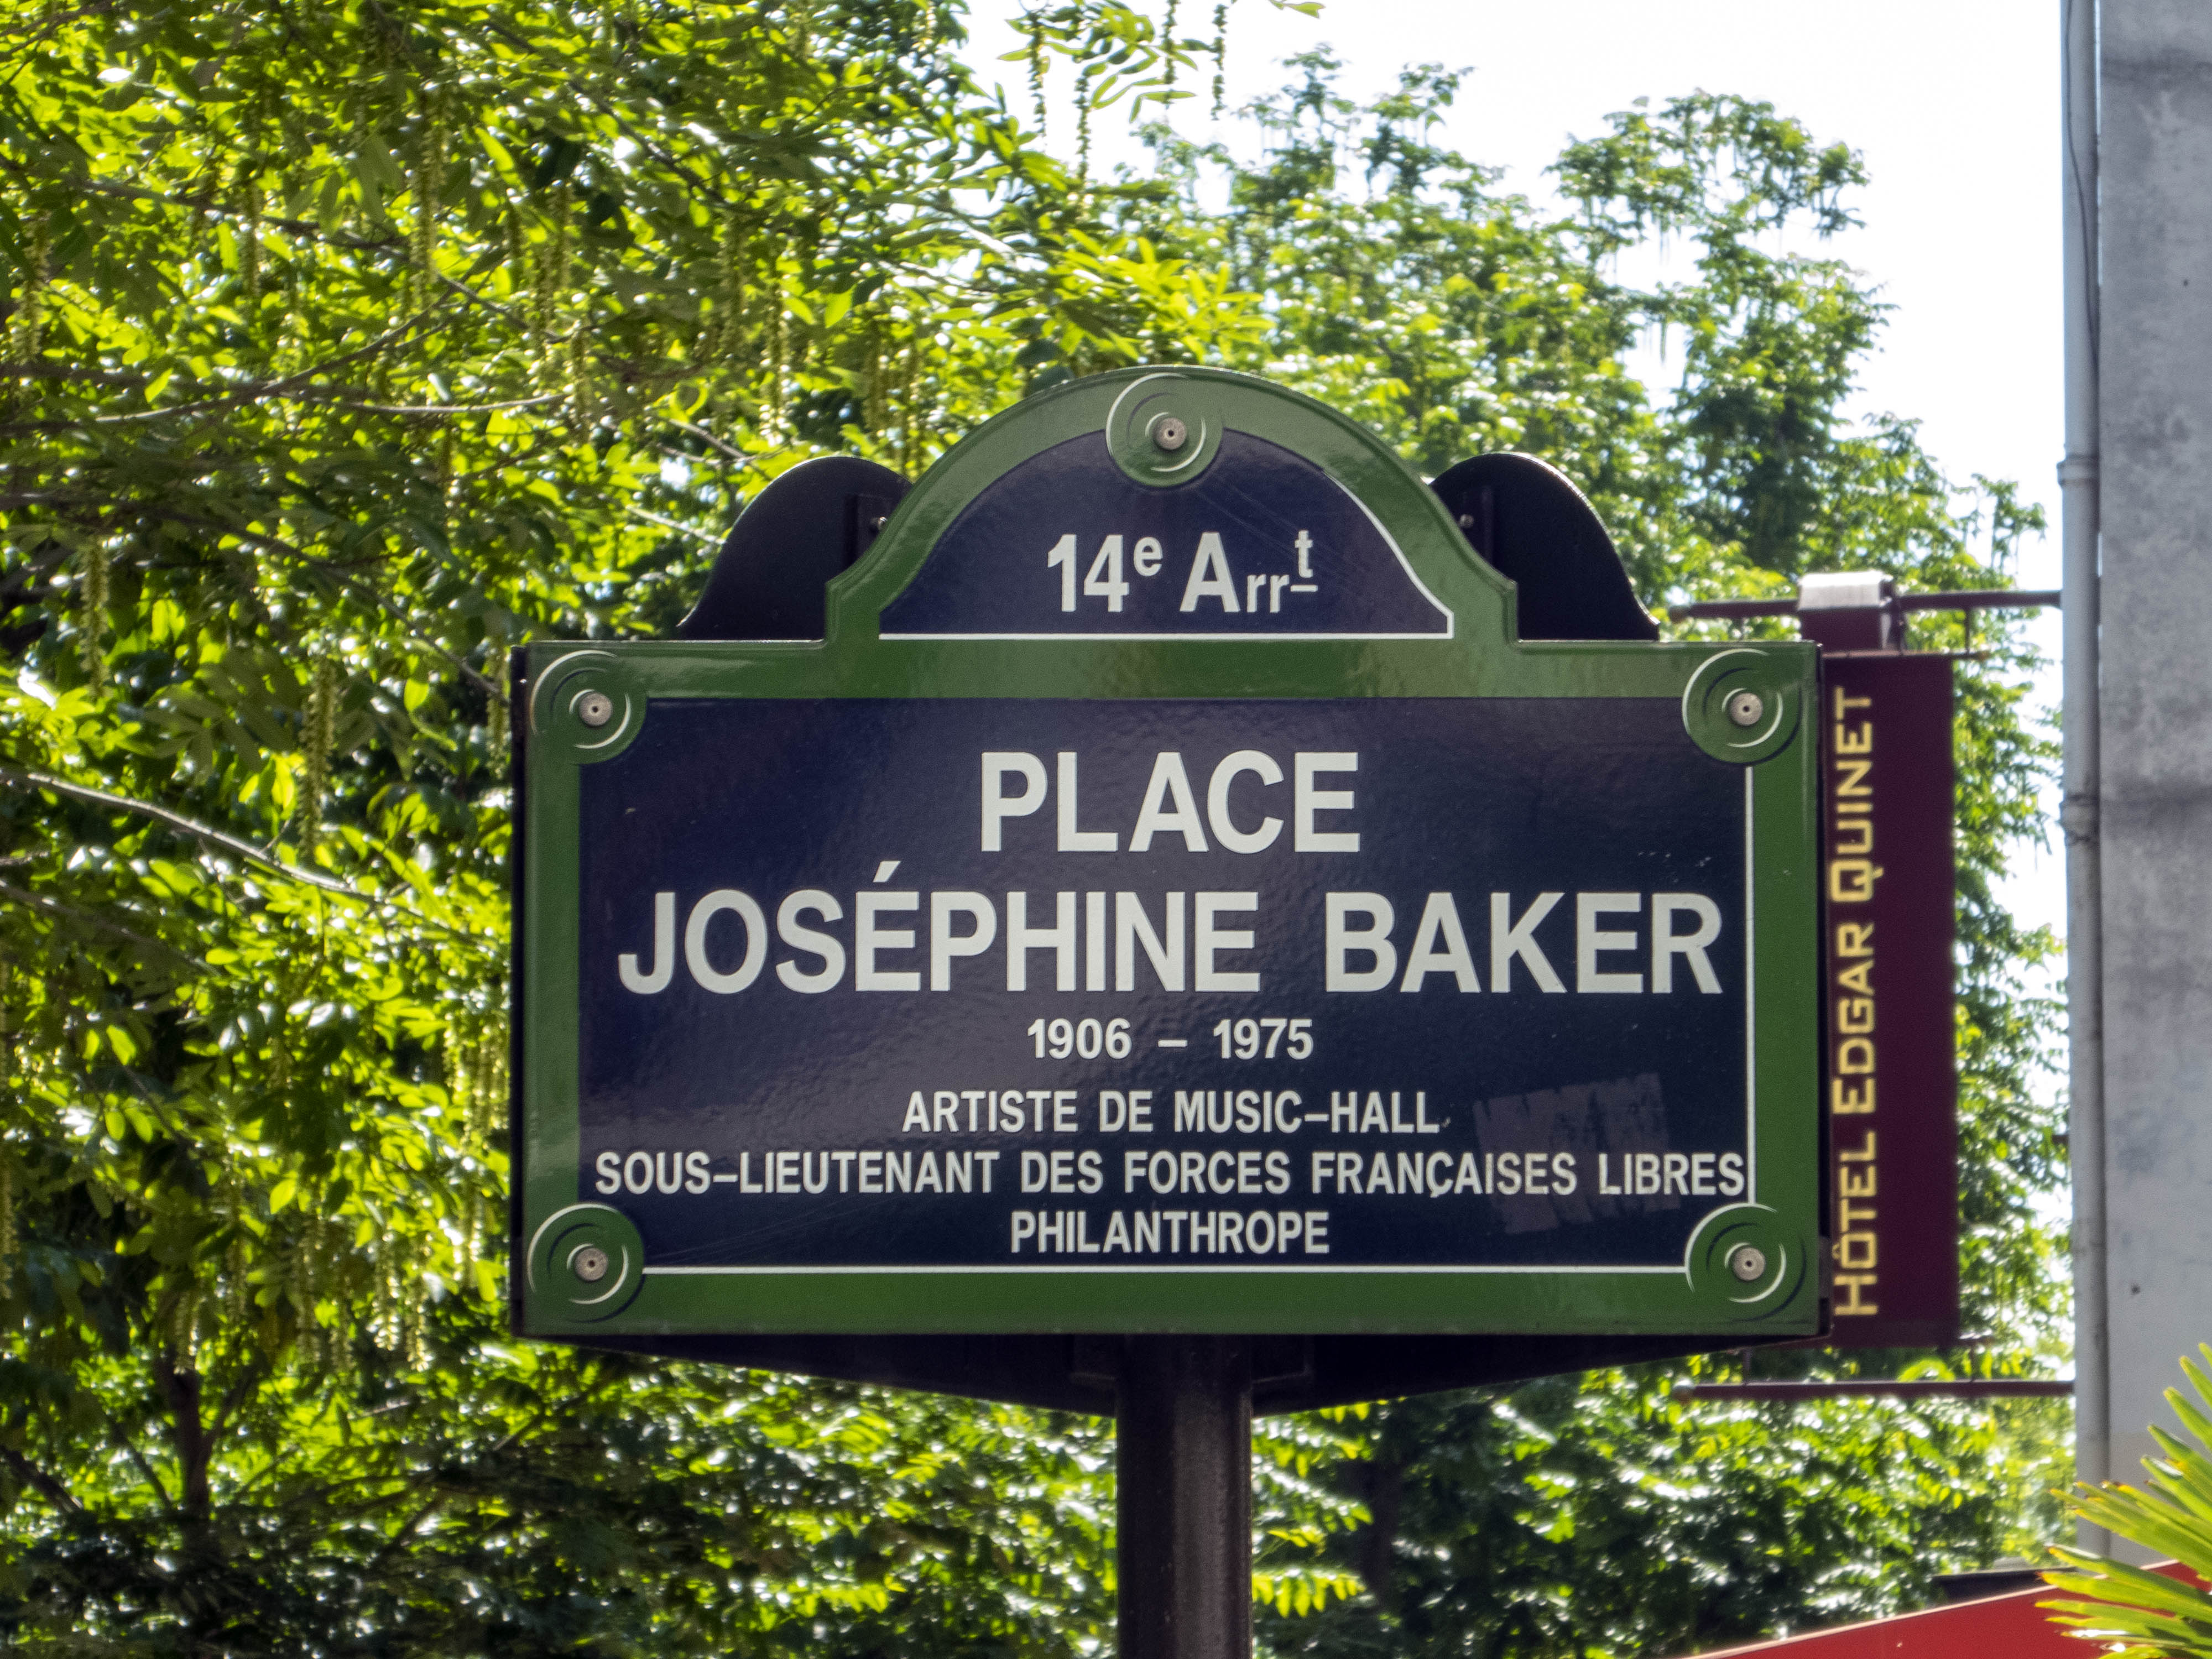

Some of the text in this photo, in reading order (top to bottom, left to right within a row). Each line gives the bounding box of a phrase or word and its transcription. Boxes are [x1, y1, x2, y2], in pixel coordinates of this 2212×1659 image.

[980, 749, 1361, 854] PLACE
[618, 860, 1723, 995] JOSÉPHINE BAKER
[1830, 686, 1884, 1316] HÔTEL EDGAR QUINET
[1027, 1017, 1132, 1060] 1906
[1213, 1018, 1314, 1060] 1975
[901, 1089, 1440, 1134] ARTISTE DE MUSIC-HALL
[596, 1150, 1745, 1198] SOUS-LIEUTENANT DES FORCES FRANÇAISES LIBRES
[1011, 1210, 1329, 1254] PHILANTHROPE
